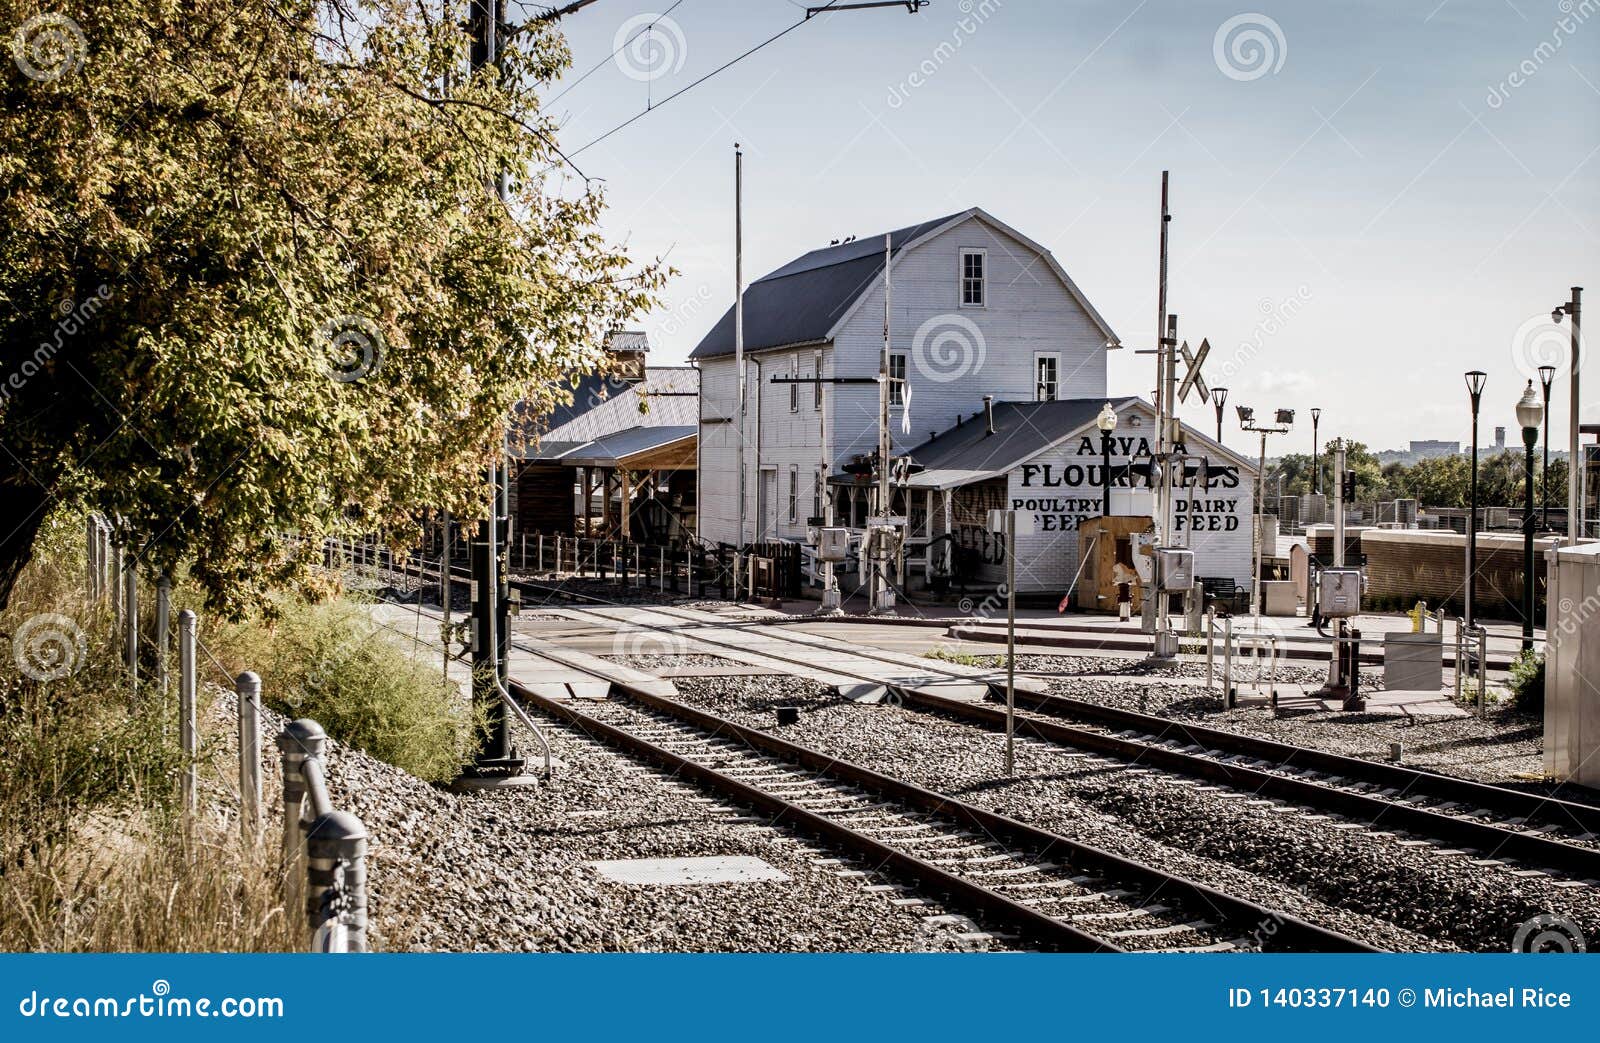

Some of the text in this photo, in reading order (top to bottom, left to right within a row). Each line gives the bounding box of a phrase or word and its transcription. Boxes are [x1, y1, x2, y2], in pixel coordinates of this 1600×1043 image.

[1077, 437, 1188, 455] ARVAA
[1142, 466, 1240, 488] LLS
[1012, 499, 1102, 511] POULTRY
[1175, 500, 1238, 512] DAIRY
[1175, 515, 1239, 531] FEED
